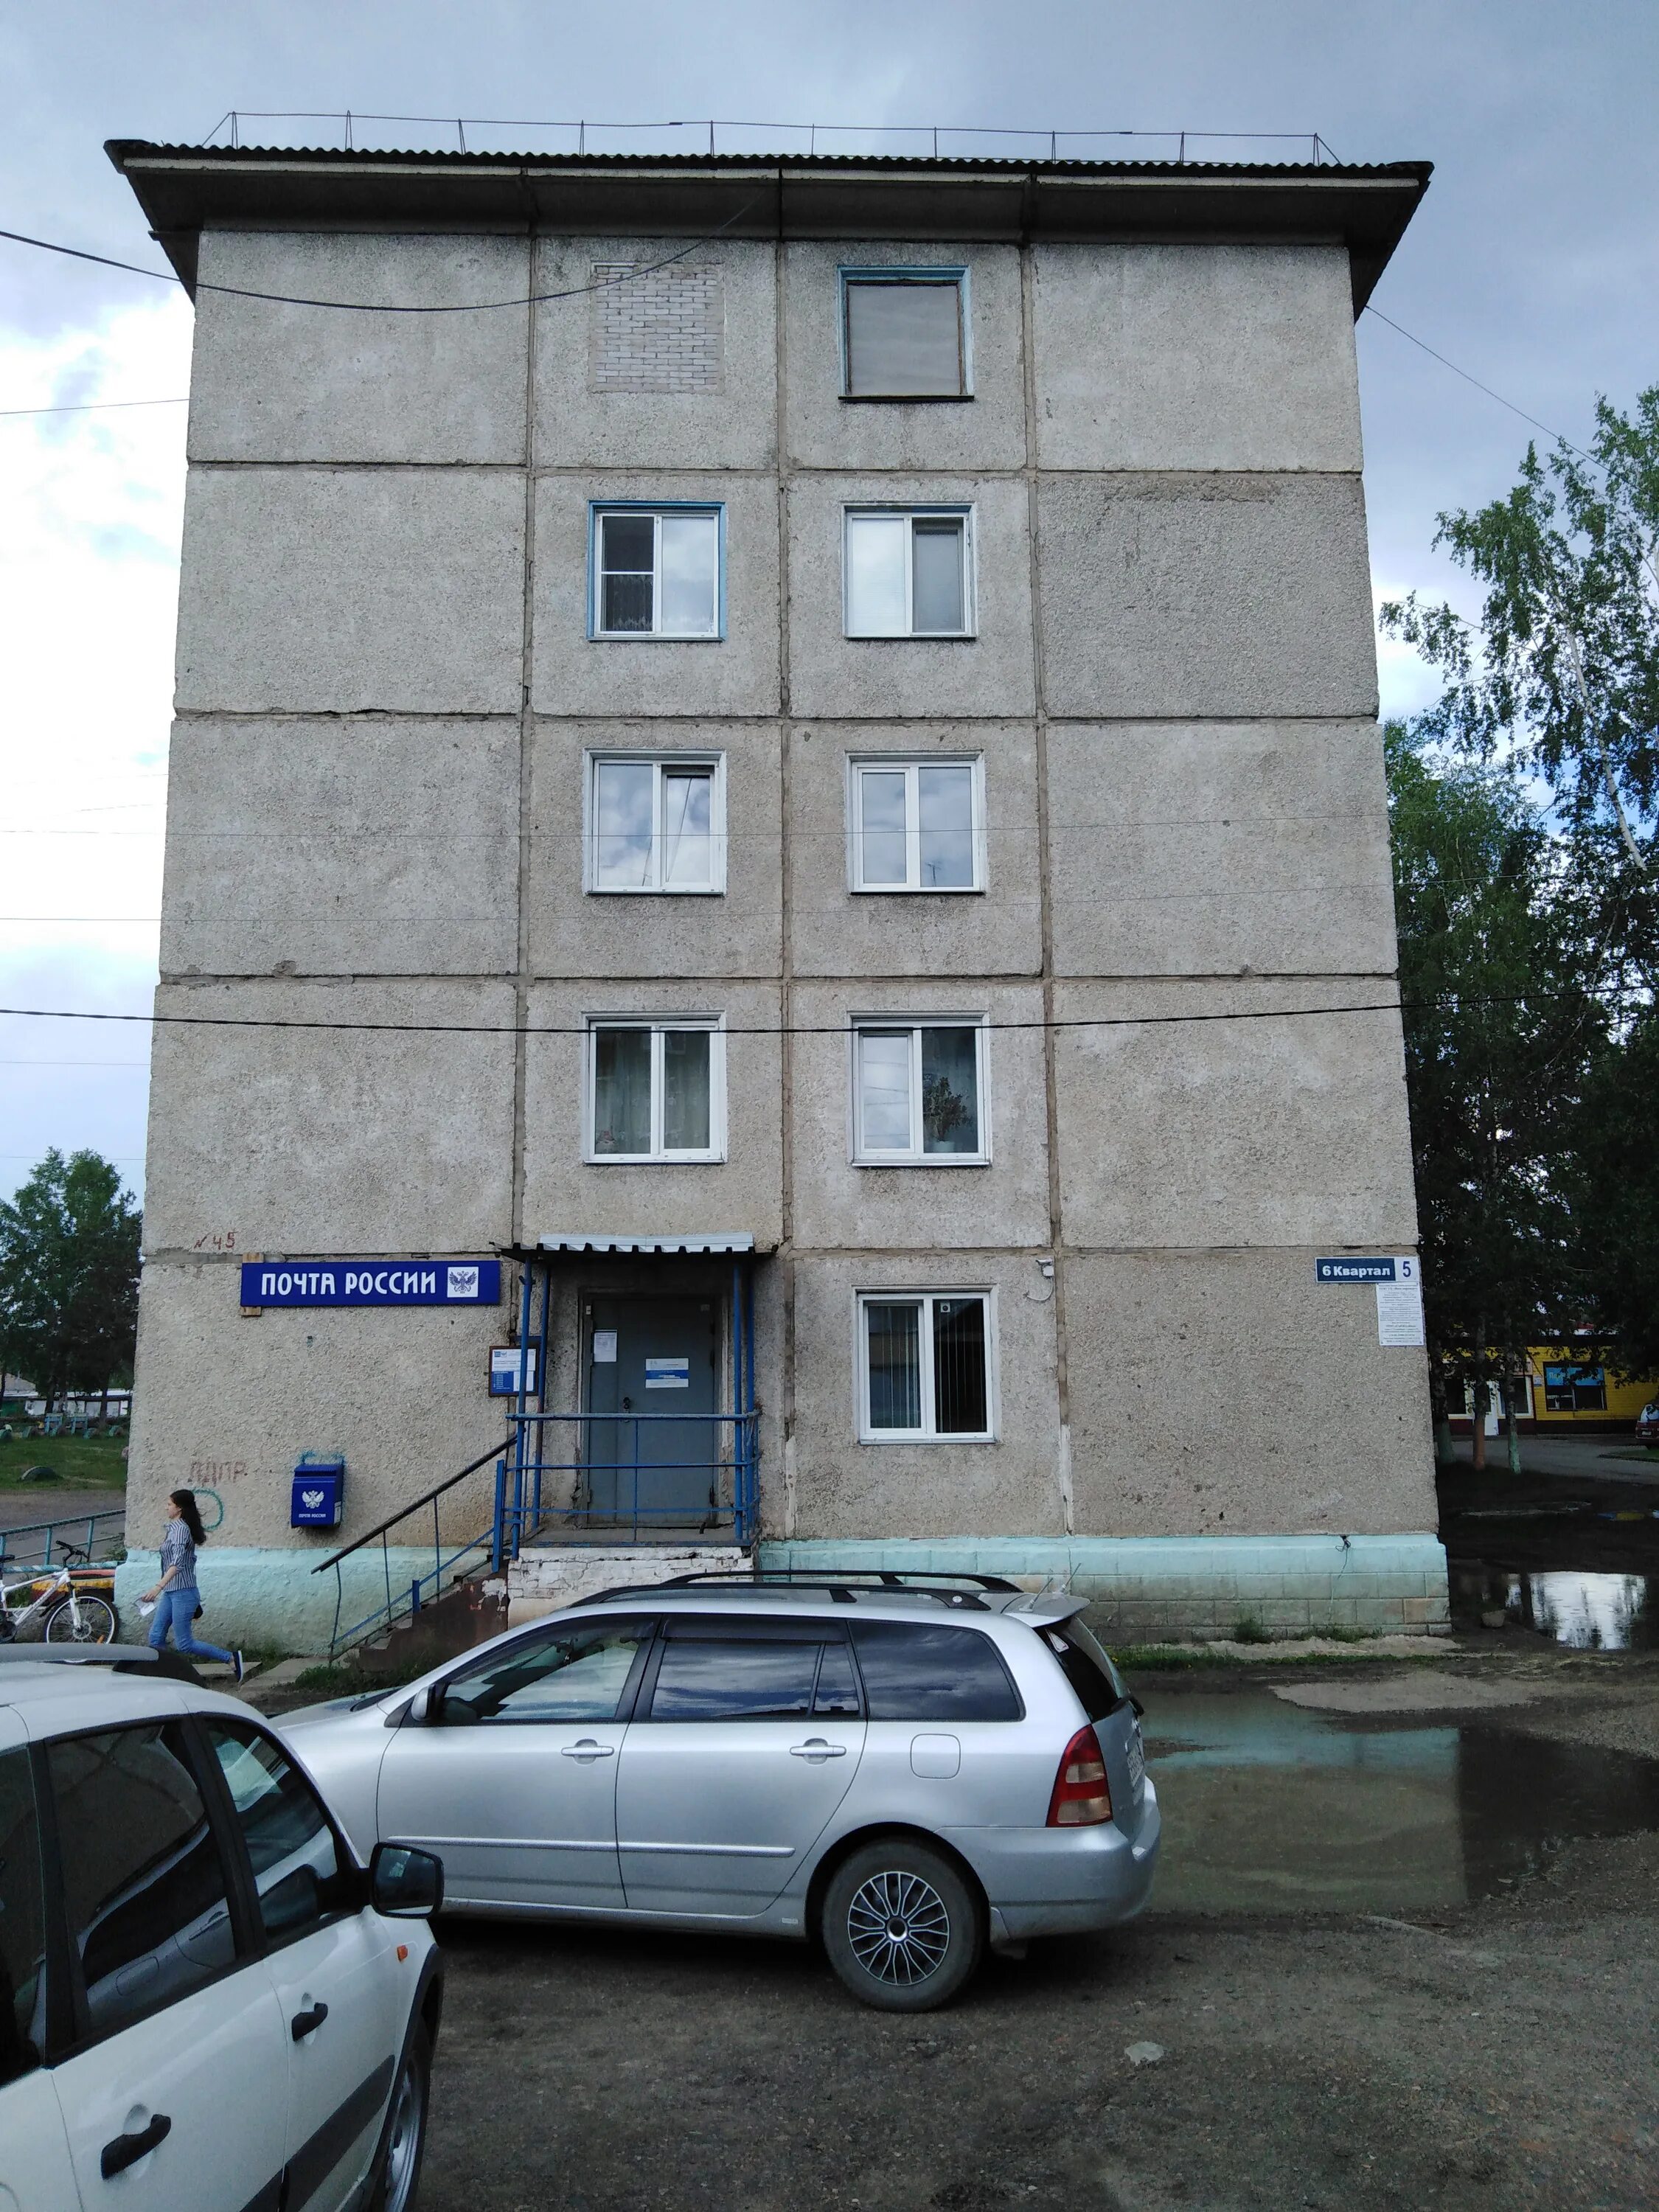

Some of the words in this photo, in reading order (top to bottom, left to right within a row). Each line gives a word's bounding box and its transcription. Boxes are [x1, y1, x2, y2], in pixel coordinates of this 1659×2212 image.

[213, 1231, 237, 1250] 45
[1322, 1265, 1332, 1276] 6
[1333, 1265, 1391, 1278] Квартал
[1402, 1261, 1411, 1277] 5
[261, 1273, 335, 1295] ПОЧТА
[345, 1271, 436, 1295] РОССИИ
